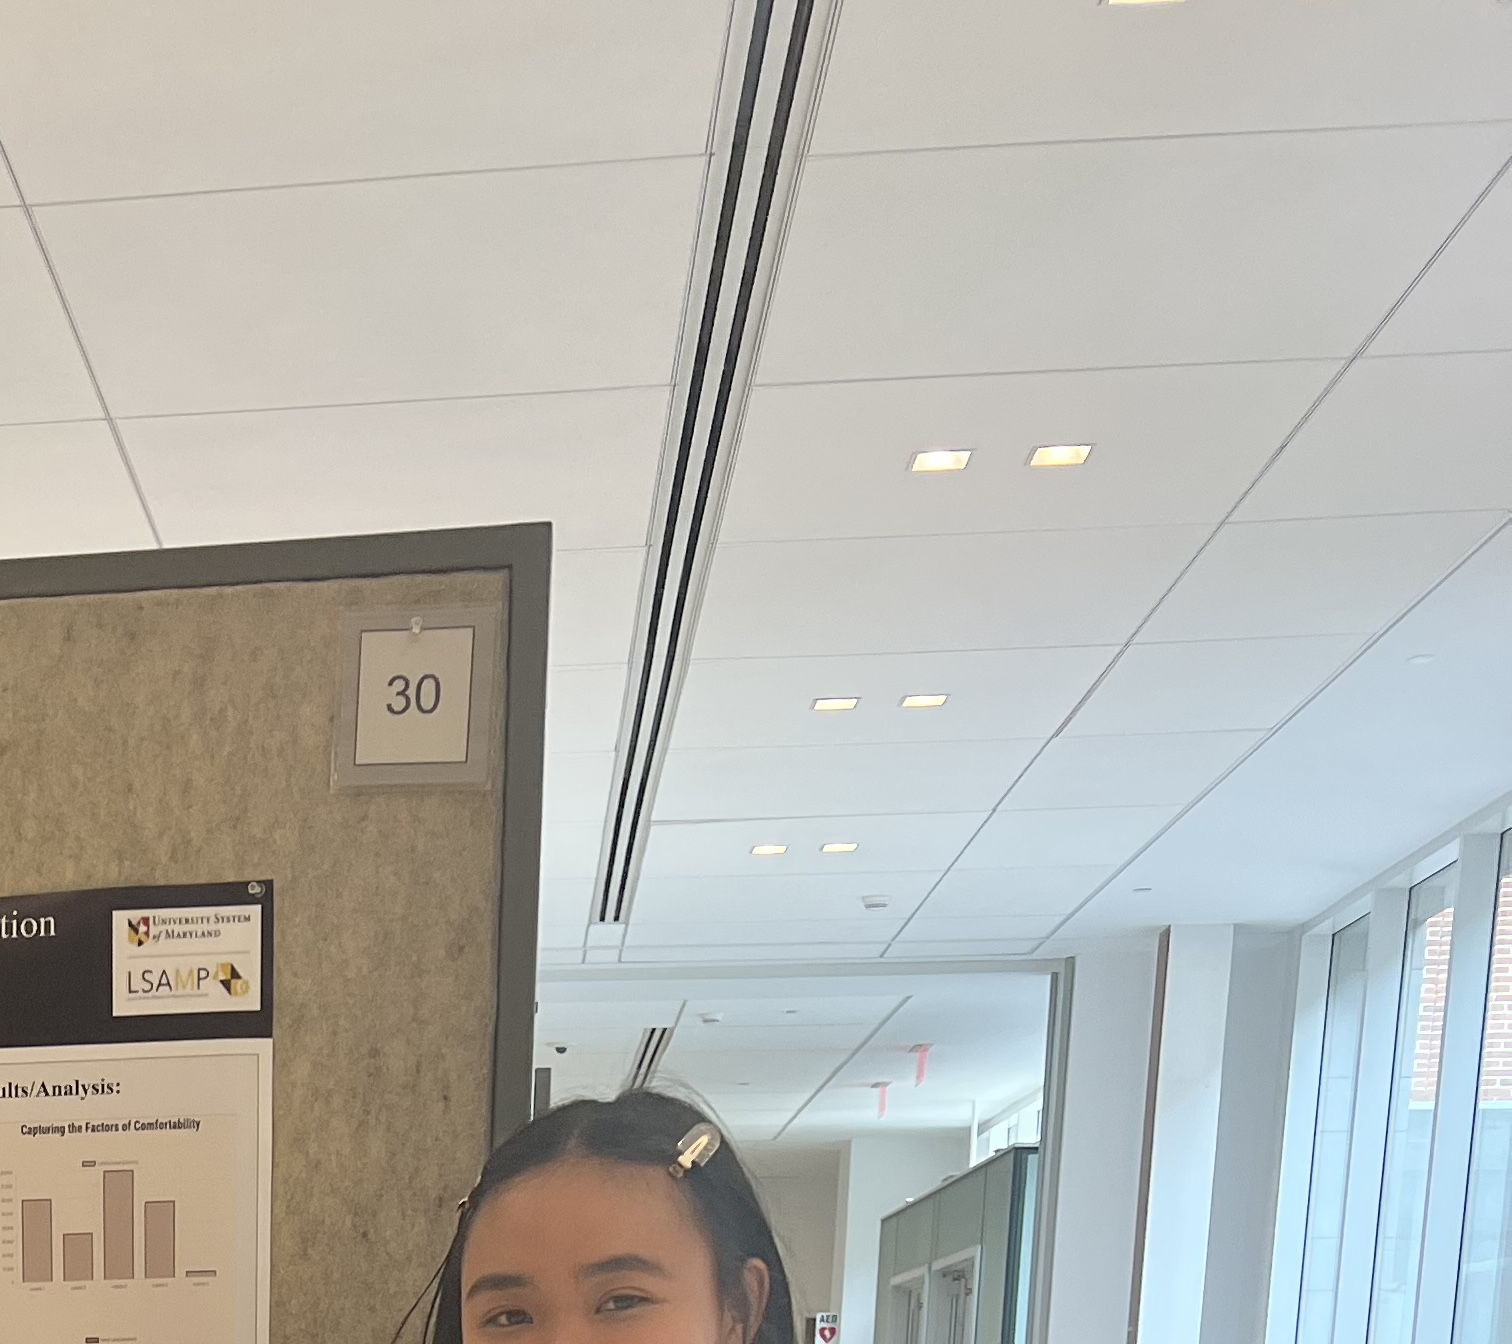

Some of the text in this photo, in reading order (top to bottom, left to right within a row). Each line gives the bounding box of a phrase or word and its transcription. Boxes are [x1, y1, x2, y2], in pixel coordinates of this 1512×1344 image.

[386, 673, 441, 715] 30
[152, 913, 251, 926] UNIVERSITY SYSTEM
[152, 929, 222, 943] of MARYLAND
[127, 967, 210, 994] LSAMP
[20, 1118, 201, 1137] Capturing the Factors of Comfortability
[819, 1314, 838, 1324] AED
